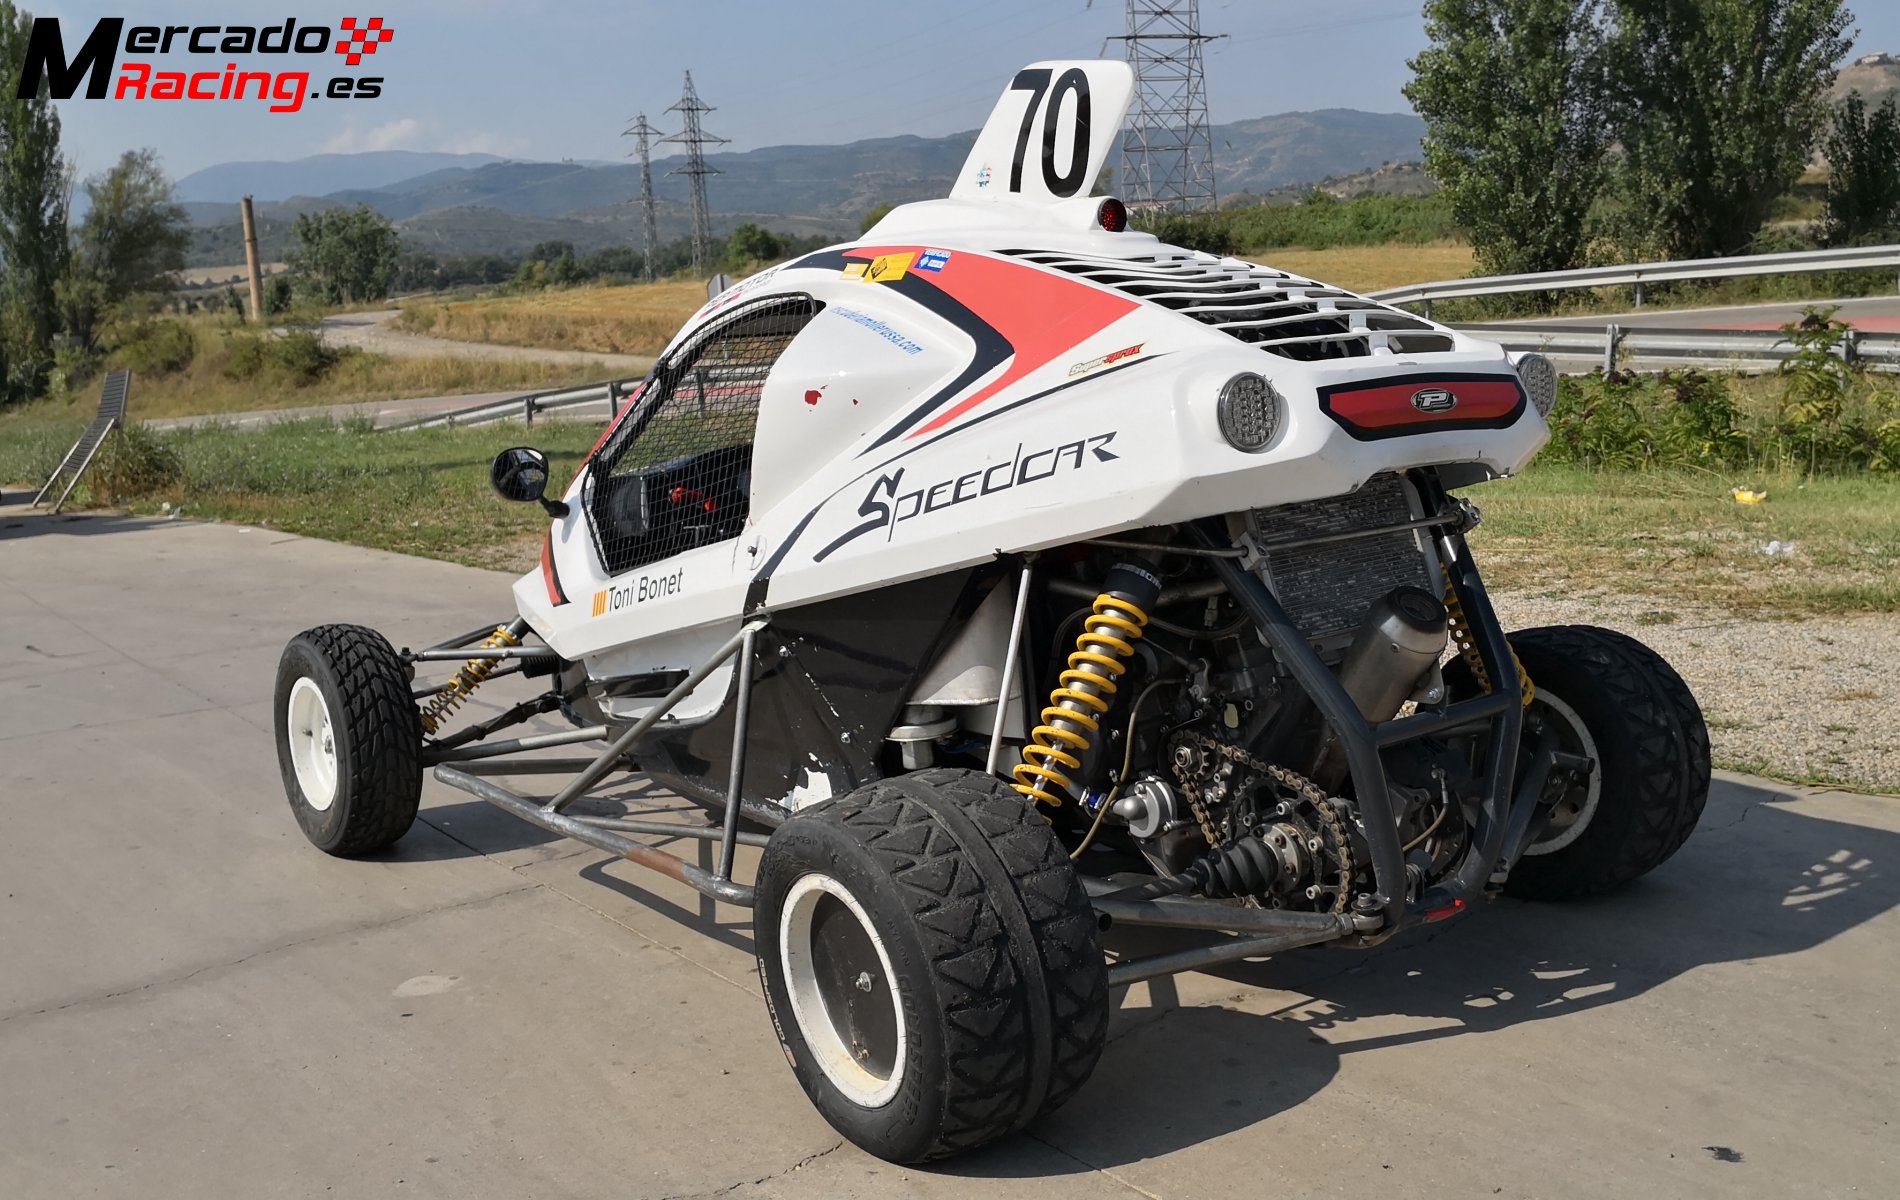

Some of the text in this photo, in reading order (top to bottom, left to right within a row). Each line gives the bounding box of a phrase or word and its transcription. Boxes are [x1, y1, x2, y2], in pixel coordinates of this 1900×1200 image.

[1009, 67, 1092, 198] 70
[607, 567, 684, 613] Toni Bonet
